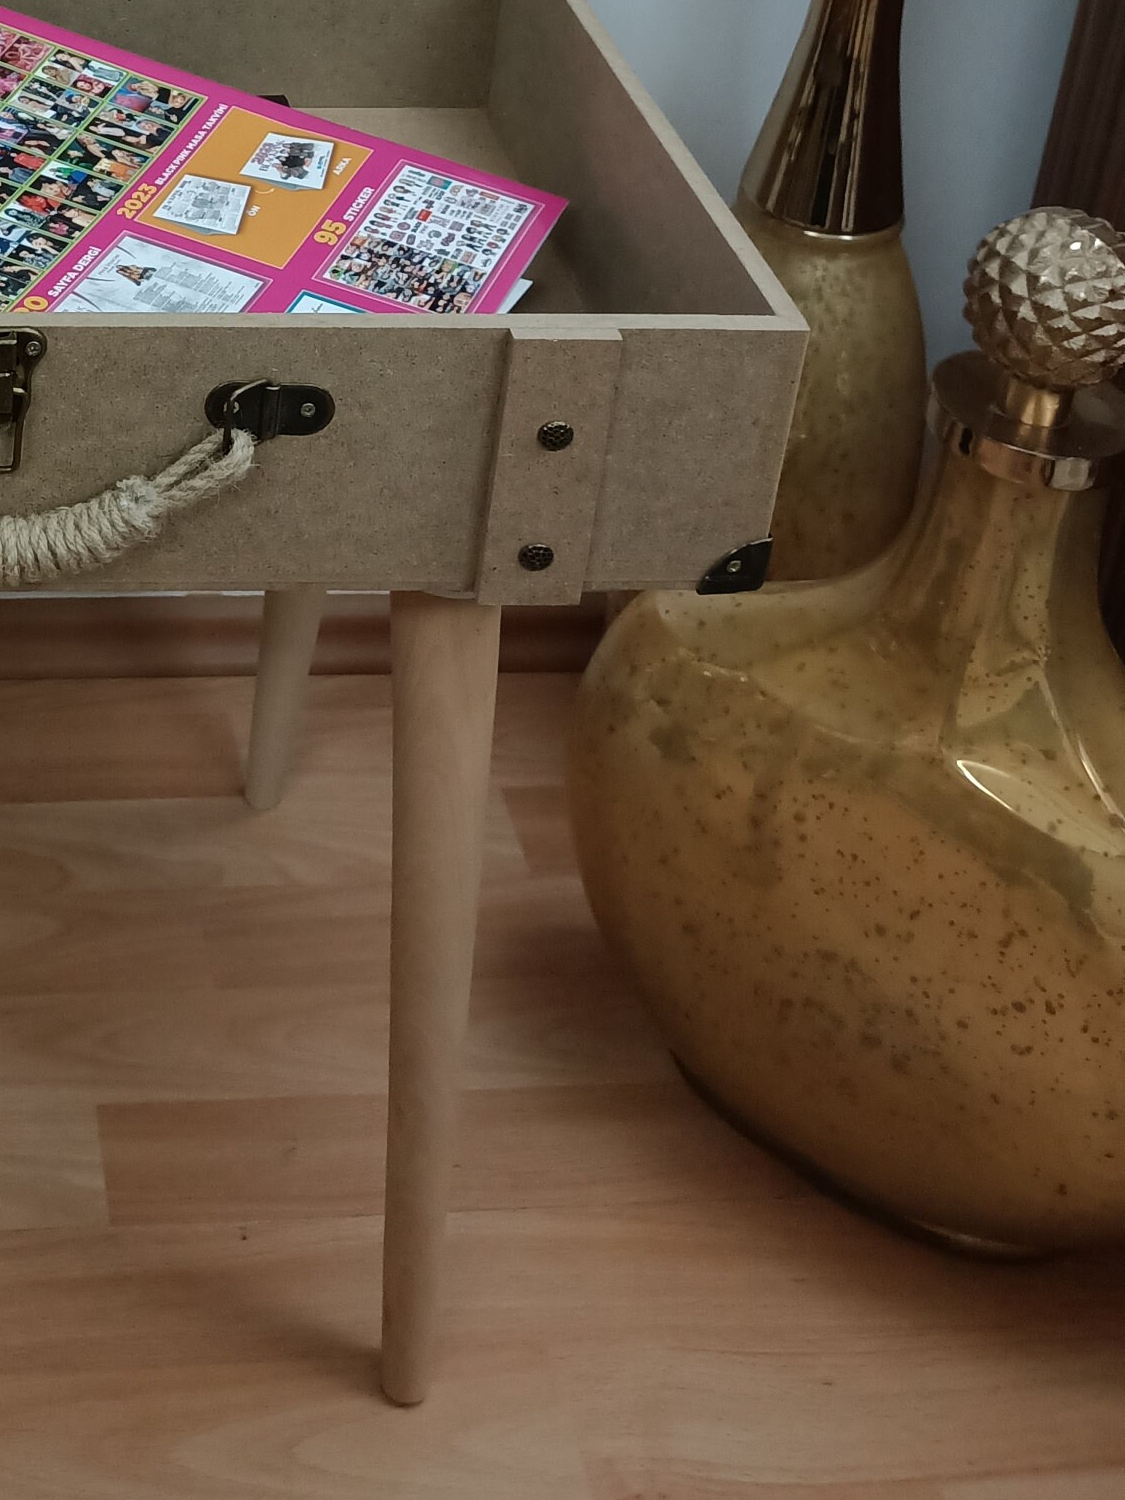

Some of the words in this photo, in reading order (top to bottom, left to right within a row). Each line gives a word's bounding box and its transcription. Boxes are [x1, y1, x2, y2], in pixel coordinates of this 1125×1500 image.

[117, 183, 157, 219] 2023
[186, 131, 207, 150] MASA
[333, 158, 352, 175] ARKA
[313, 219, 346, 246] 95
[343, 187, 375, 221] STICKER
[14, 296, 48, 312] 0
[48, 271, 79, 297] SAYFA
